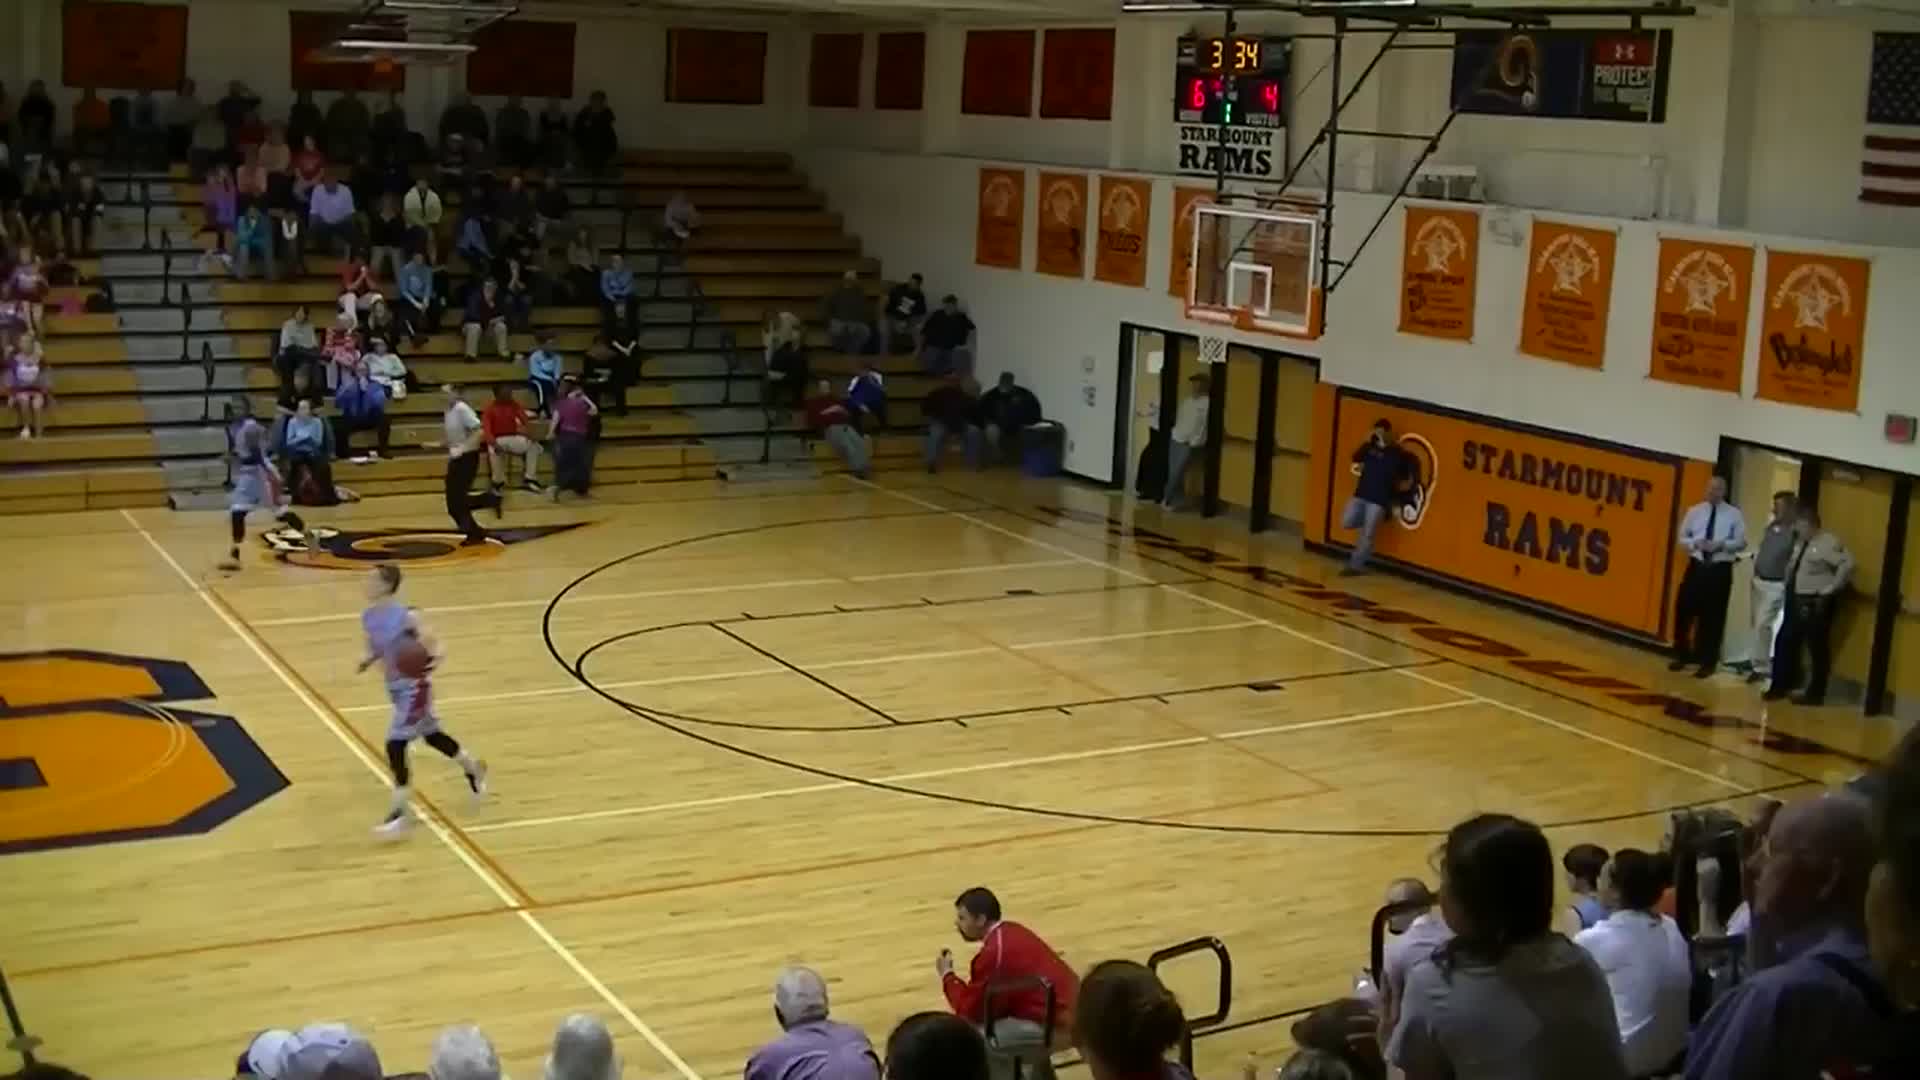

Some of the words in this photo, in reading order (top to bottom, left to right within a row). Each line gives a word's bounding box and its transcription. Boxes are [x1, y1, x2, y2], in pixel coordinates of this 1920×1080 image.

[1211, 40, 1223, 68] 3
[1193, 79, 1206, 107] 6
[1265, 83, 1278, 112] 4
[1179, 144, 1272, 176] RAMS
[1462, 439, 1653, 512] STARMOUNT
[1482, 501, 1612, 576] RAMS
